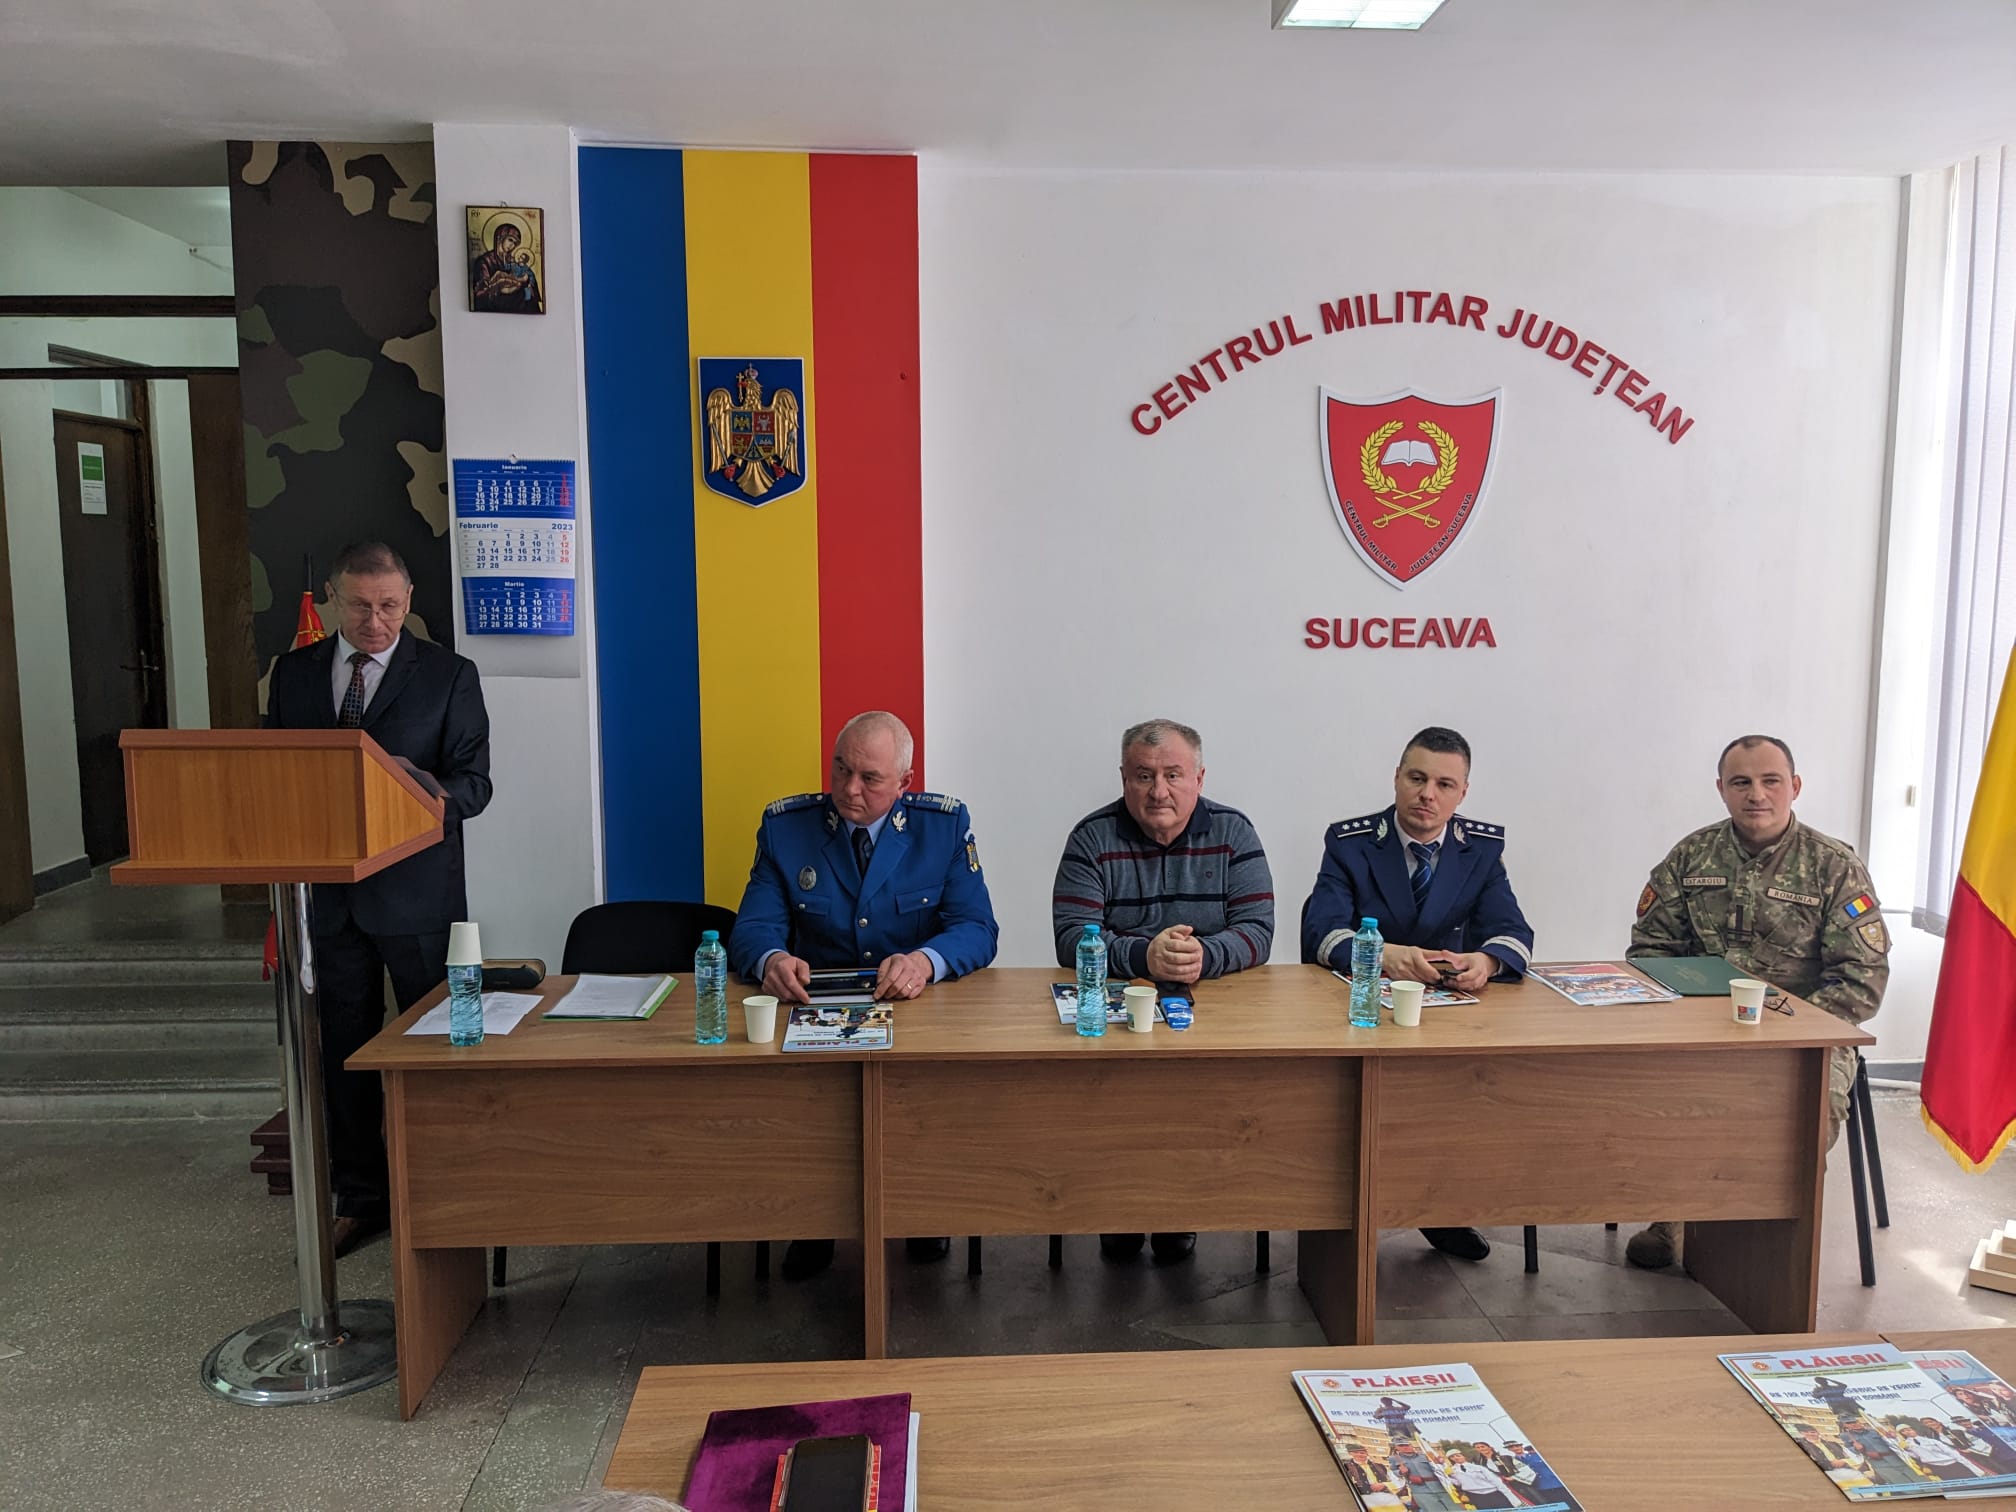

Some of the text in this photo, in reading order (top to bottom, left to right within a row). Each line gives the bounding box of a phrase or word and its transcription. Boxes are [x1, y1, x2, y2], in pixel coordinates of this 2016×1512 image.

[1131, 290, 1695, 445] CENTRUL MILITAR JUDEȚEAN
[1448, 493, 1472, 534] SUCEAVA
[1345, 499, 1398, 570] CENTRUL MILITAR
[1304, 617, 1497, 649] SUCEAVA
[1352, 1373, 1457, 1388] PLĂIEȘII
